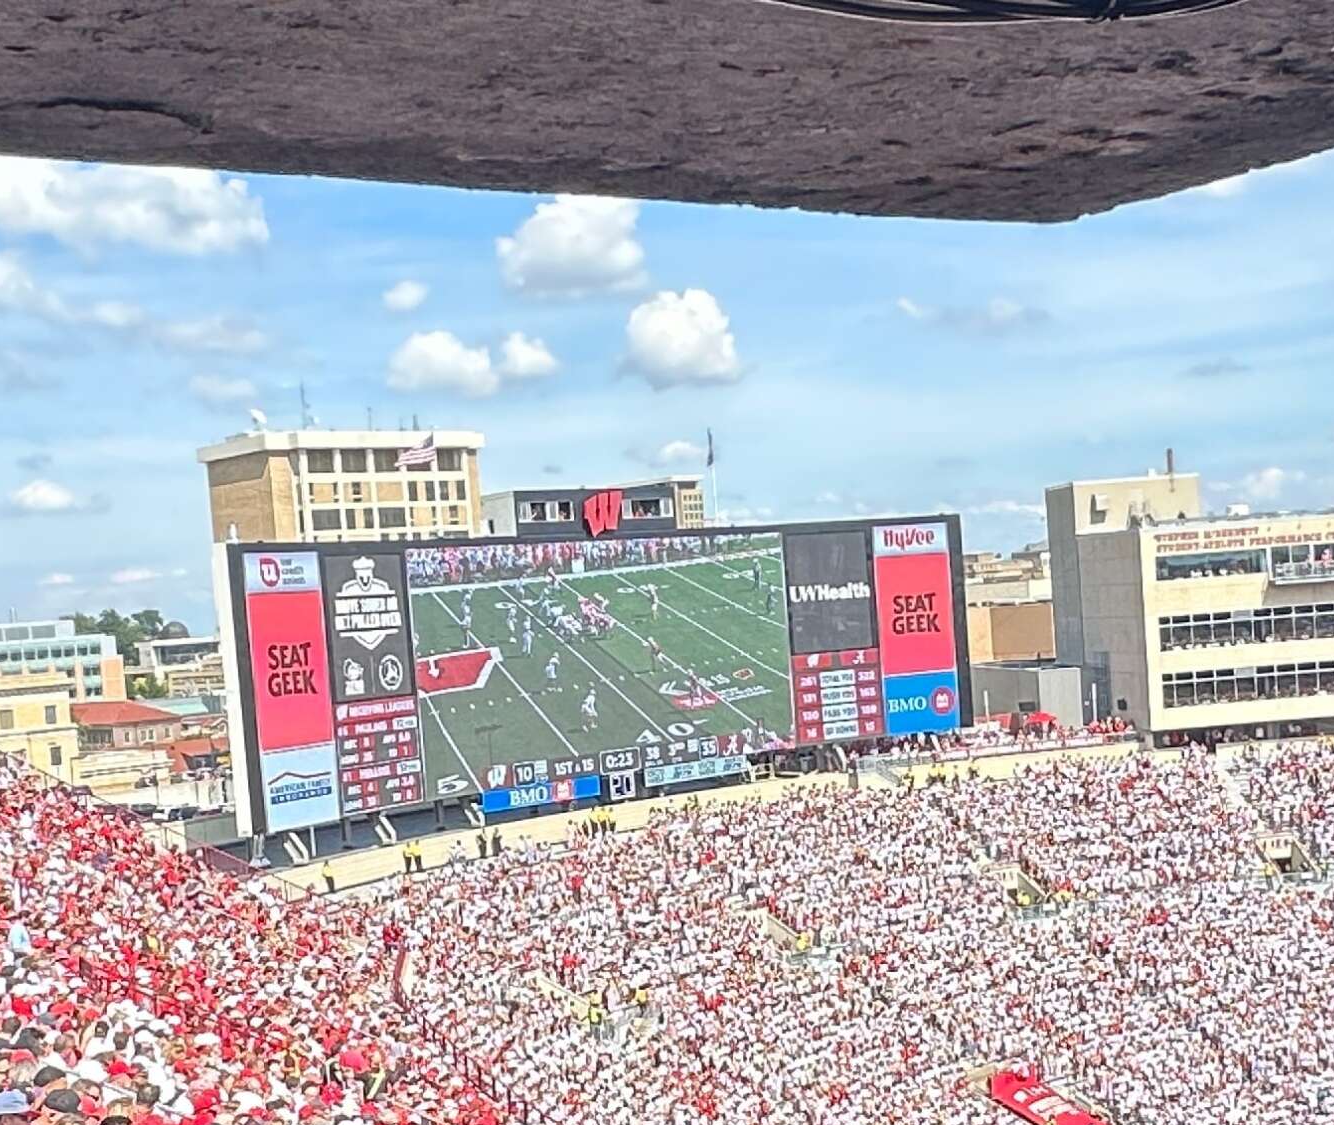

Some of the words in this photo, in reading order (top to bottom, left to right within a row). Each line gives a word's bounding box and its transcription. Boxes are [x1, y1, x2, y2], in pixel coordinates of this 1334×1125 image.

[584, 490, 622, 538] W
[893, 593, 936, 615] SEAT
[892, 613, 940, 635] GEEK
[267, 642, 311, 671] SEAT
[267, 669, 319, 697] GEEK
[888, 696, 927, 713] BMO
[517, 765, 533, 782] 10
[554, 762, 572, 776] 1ST
[581, 758, 595, 772] 15
[605, 752, 634, 768] 0:23
[701, 740, 716, 756] 35
[270, 780, 306, 795] AMERICAN
[510, 786, 548, 806] BMO
[611, 773, 633, 797] 20
